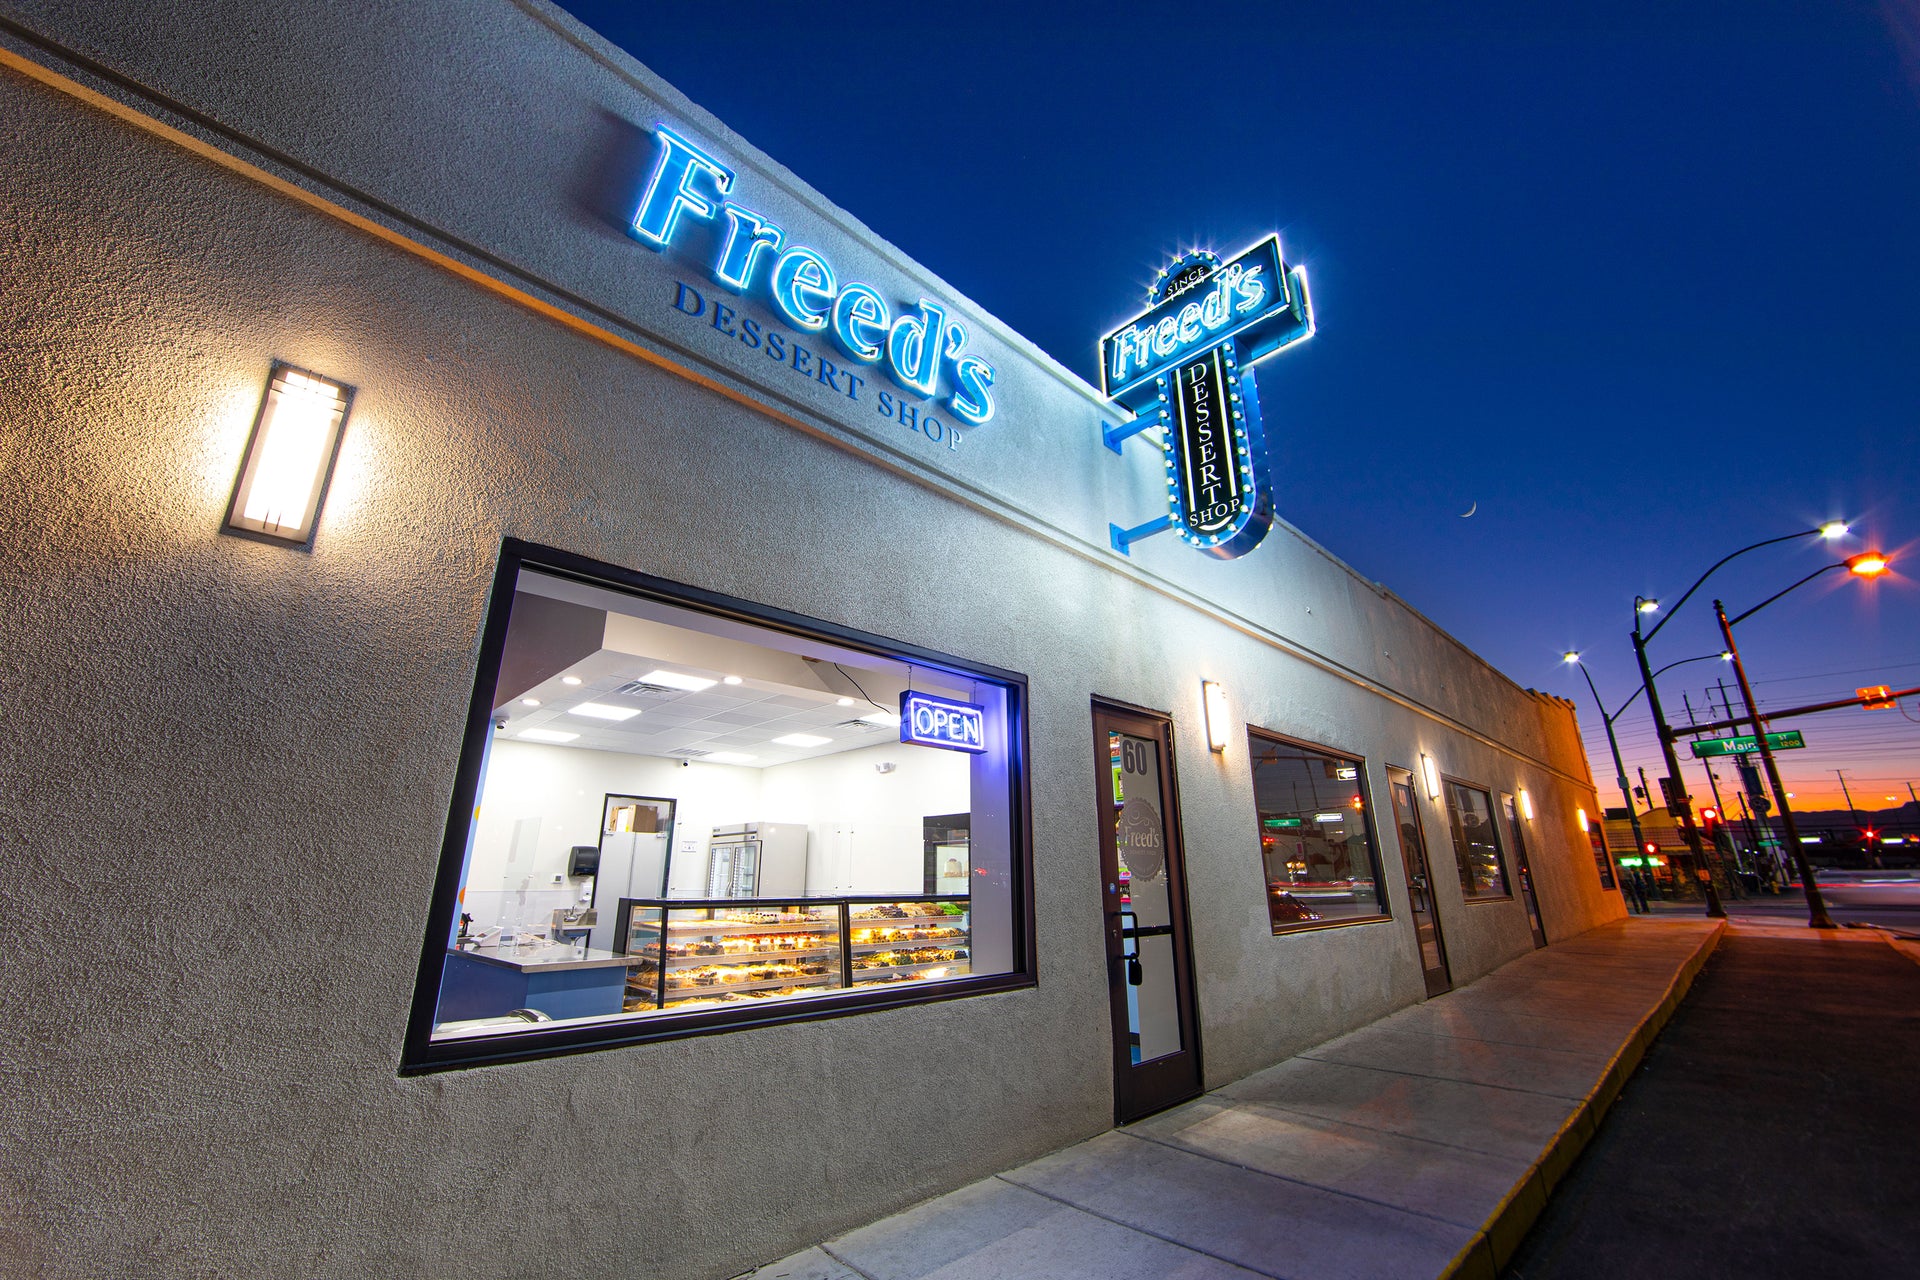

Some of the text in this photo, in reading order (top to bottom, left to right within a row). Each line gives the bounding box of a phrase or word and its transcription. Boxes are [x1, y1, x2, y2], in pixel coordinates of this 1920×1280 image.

[632, 121, 997, 427] Freed's
[1167, 266, 1205, 295] SINCE
[1112, 263, 1266, 379] Freed's
[675, 280, 963, 452] DESSERT SHOP
[1187, 362, 1223, 506] DESSERT
[1189, 498, 1241, 528] SHOP
[916, 706, 979, 743] OPEN
[1122, 739, 1148, 776] 60
[1722, 740, 1757, 752] Main
[1124, 826, 1160, 848] Freed's
